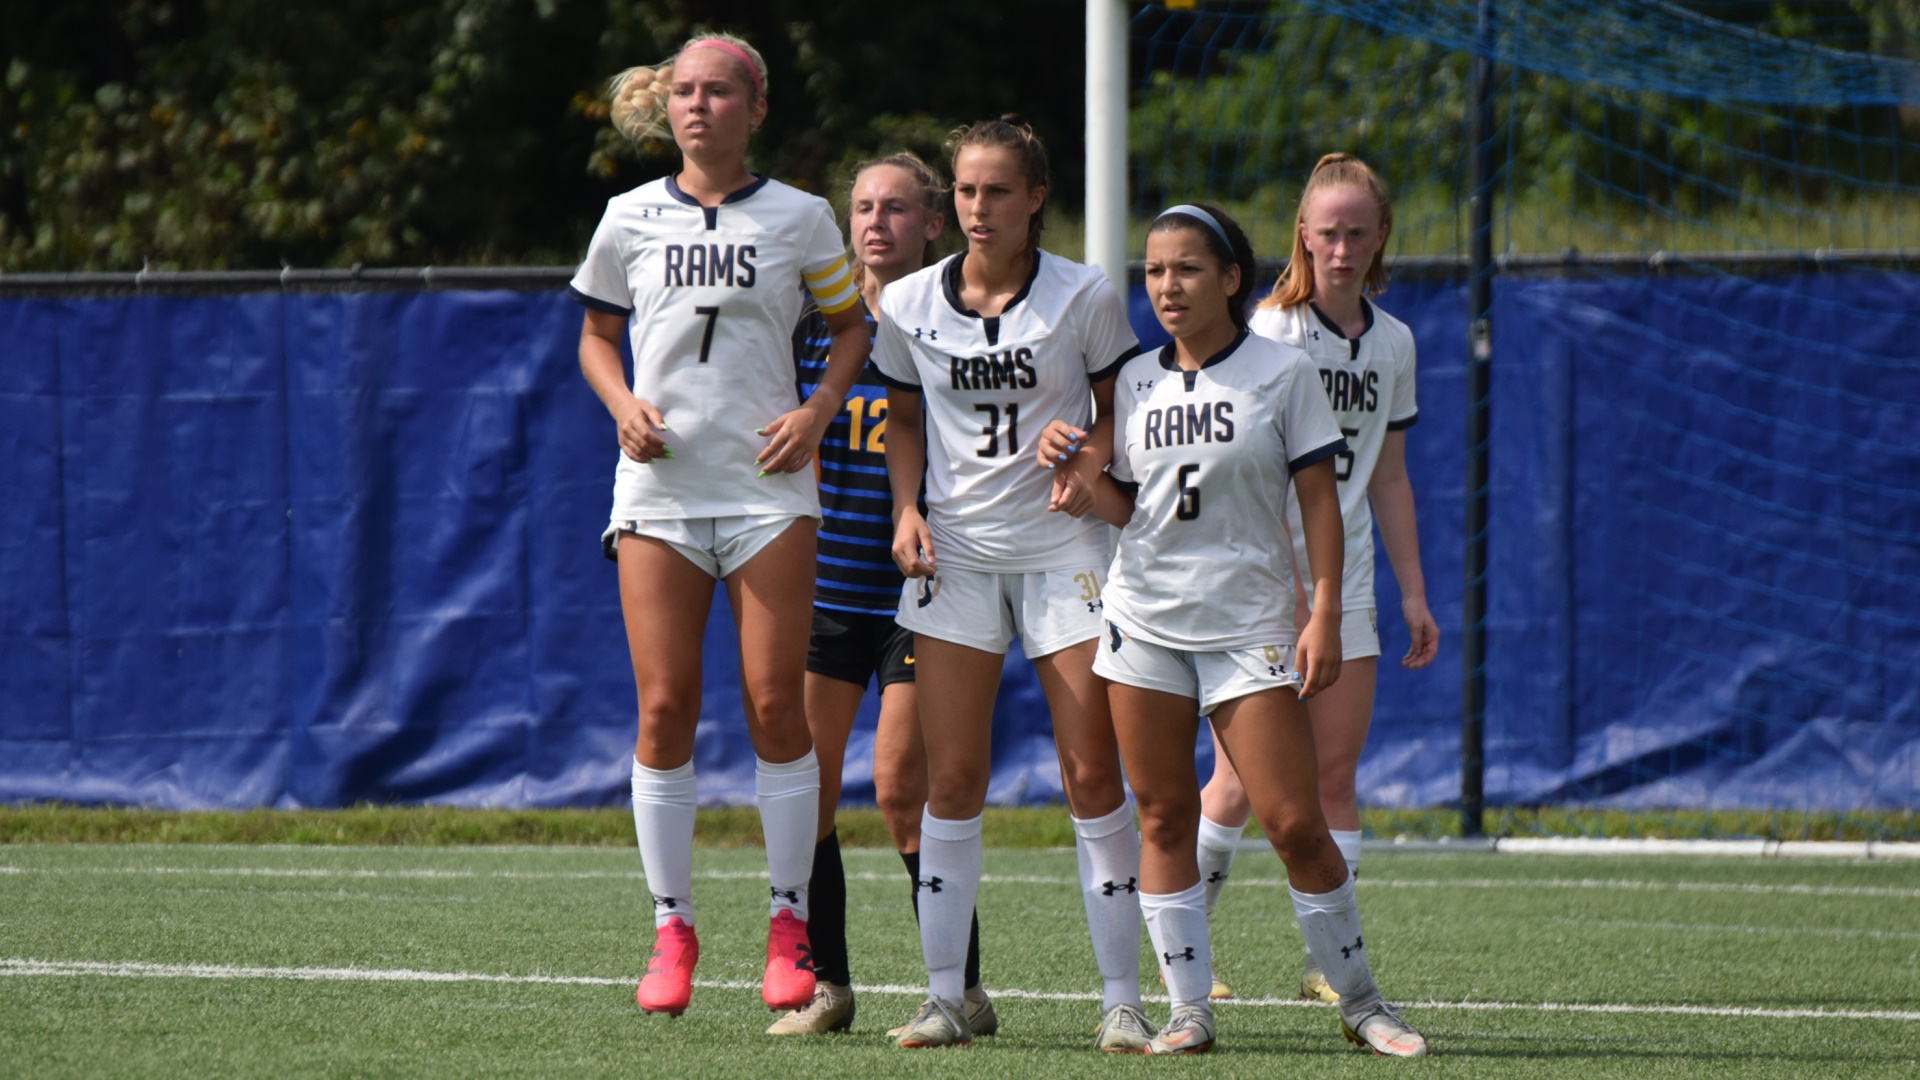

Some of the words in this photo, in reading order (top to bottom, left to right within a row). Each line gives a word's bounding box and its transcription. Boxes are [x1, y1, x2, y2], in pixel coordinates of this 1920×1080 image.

[665, 244, 757, 288] RAMS
[694, 306, 720, 364] 7
[950, 347, 1037, 391] RAMS
[1318, 368, 1379, 413] RAMS
[846, 396, 888, 454] 12
[973, 402, 1019, 458] 31
[1144, 400, 1235, 450] RAMS
[1176, 463, 1201, 521] 6
[1073, 569, 1101, 602] 31
